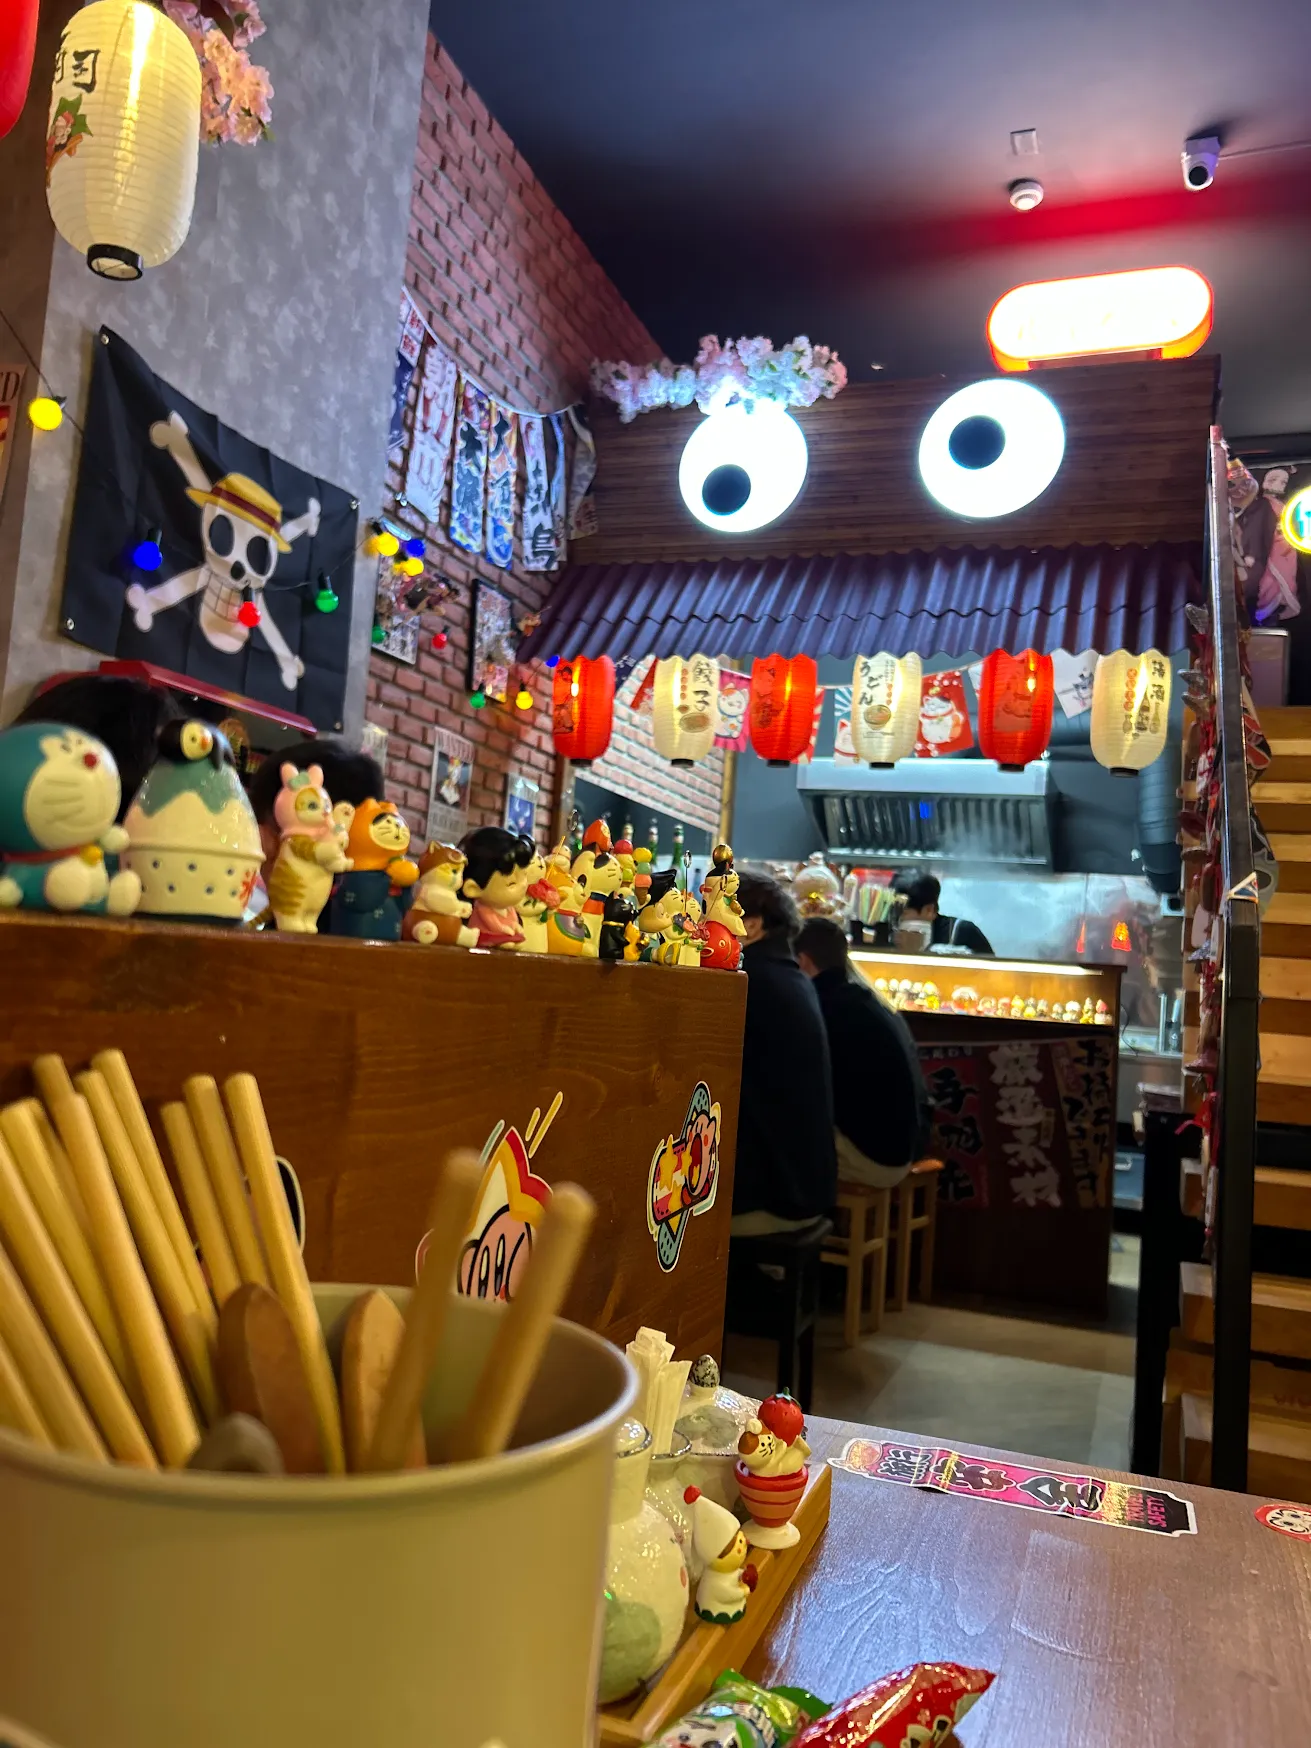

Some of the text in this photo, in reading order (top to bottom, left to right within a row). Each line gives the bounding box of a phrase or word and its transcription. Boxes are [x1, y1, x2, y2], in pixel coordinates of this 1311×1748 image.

[858, 661, 883, 706] うどん
[1127, 1491, 1145, 1523] TRAVEL
[1147, 1495, 1168, 1528] SAFETY
